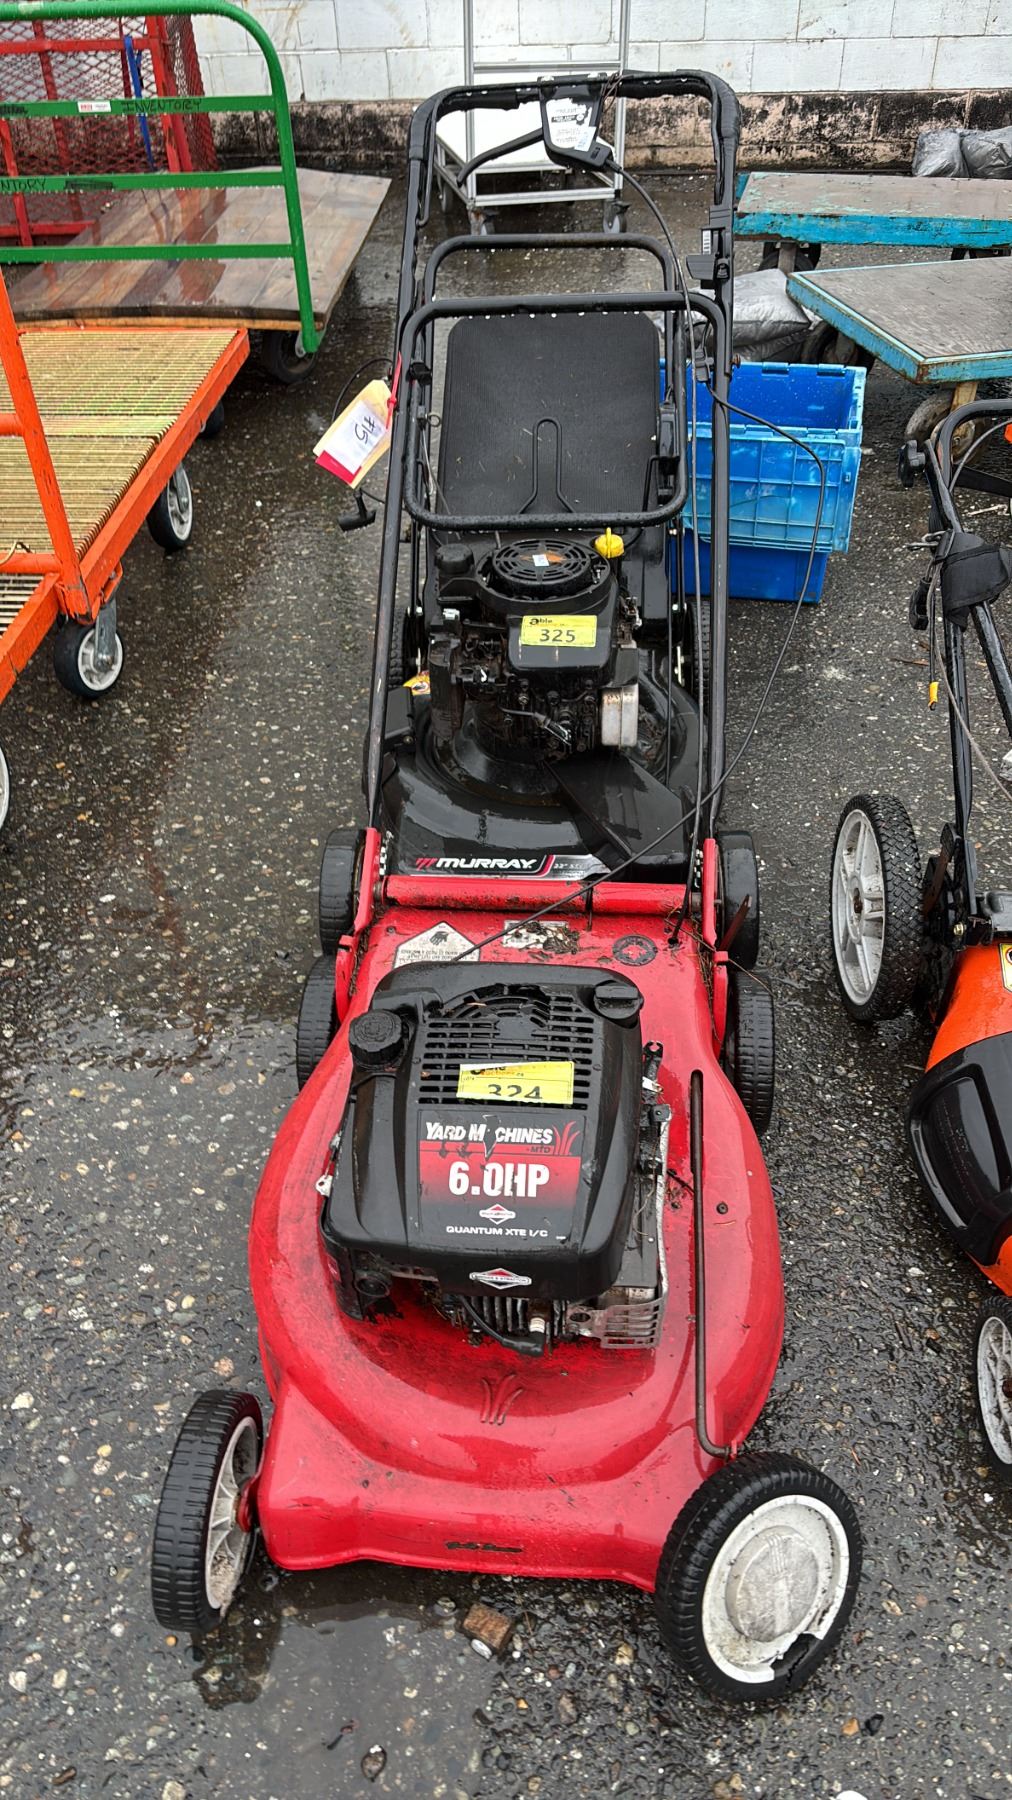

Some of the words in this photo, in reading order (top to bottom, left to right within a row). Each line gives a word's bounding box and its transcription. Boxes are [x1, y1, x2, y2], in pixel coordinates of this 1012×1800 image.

[121, 98, 201, 112] INVENTORY
[539, 628, 576, 643] 325
[436, 857, 537, 869] MURRAY
[487, 1083, 543, 1100] 324
[426, 1122, 466, 1141] YARD
[468, 1123, 553, 1145] MCHINES
[448, 1160, 550, 1198] 6.0HP
[446, 1225, 503, 1236] QUANTUM
[505, 1228, 527, 1237] XTE
[529, 1229, 549, 1238] I/C
